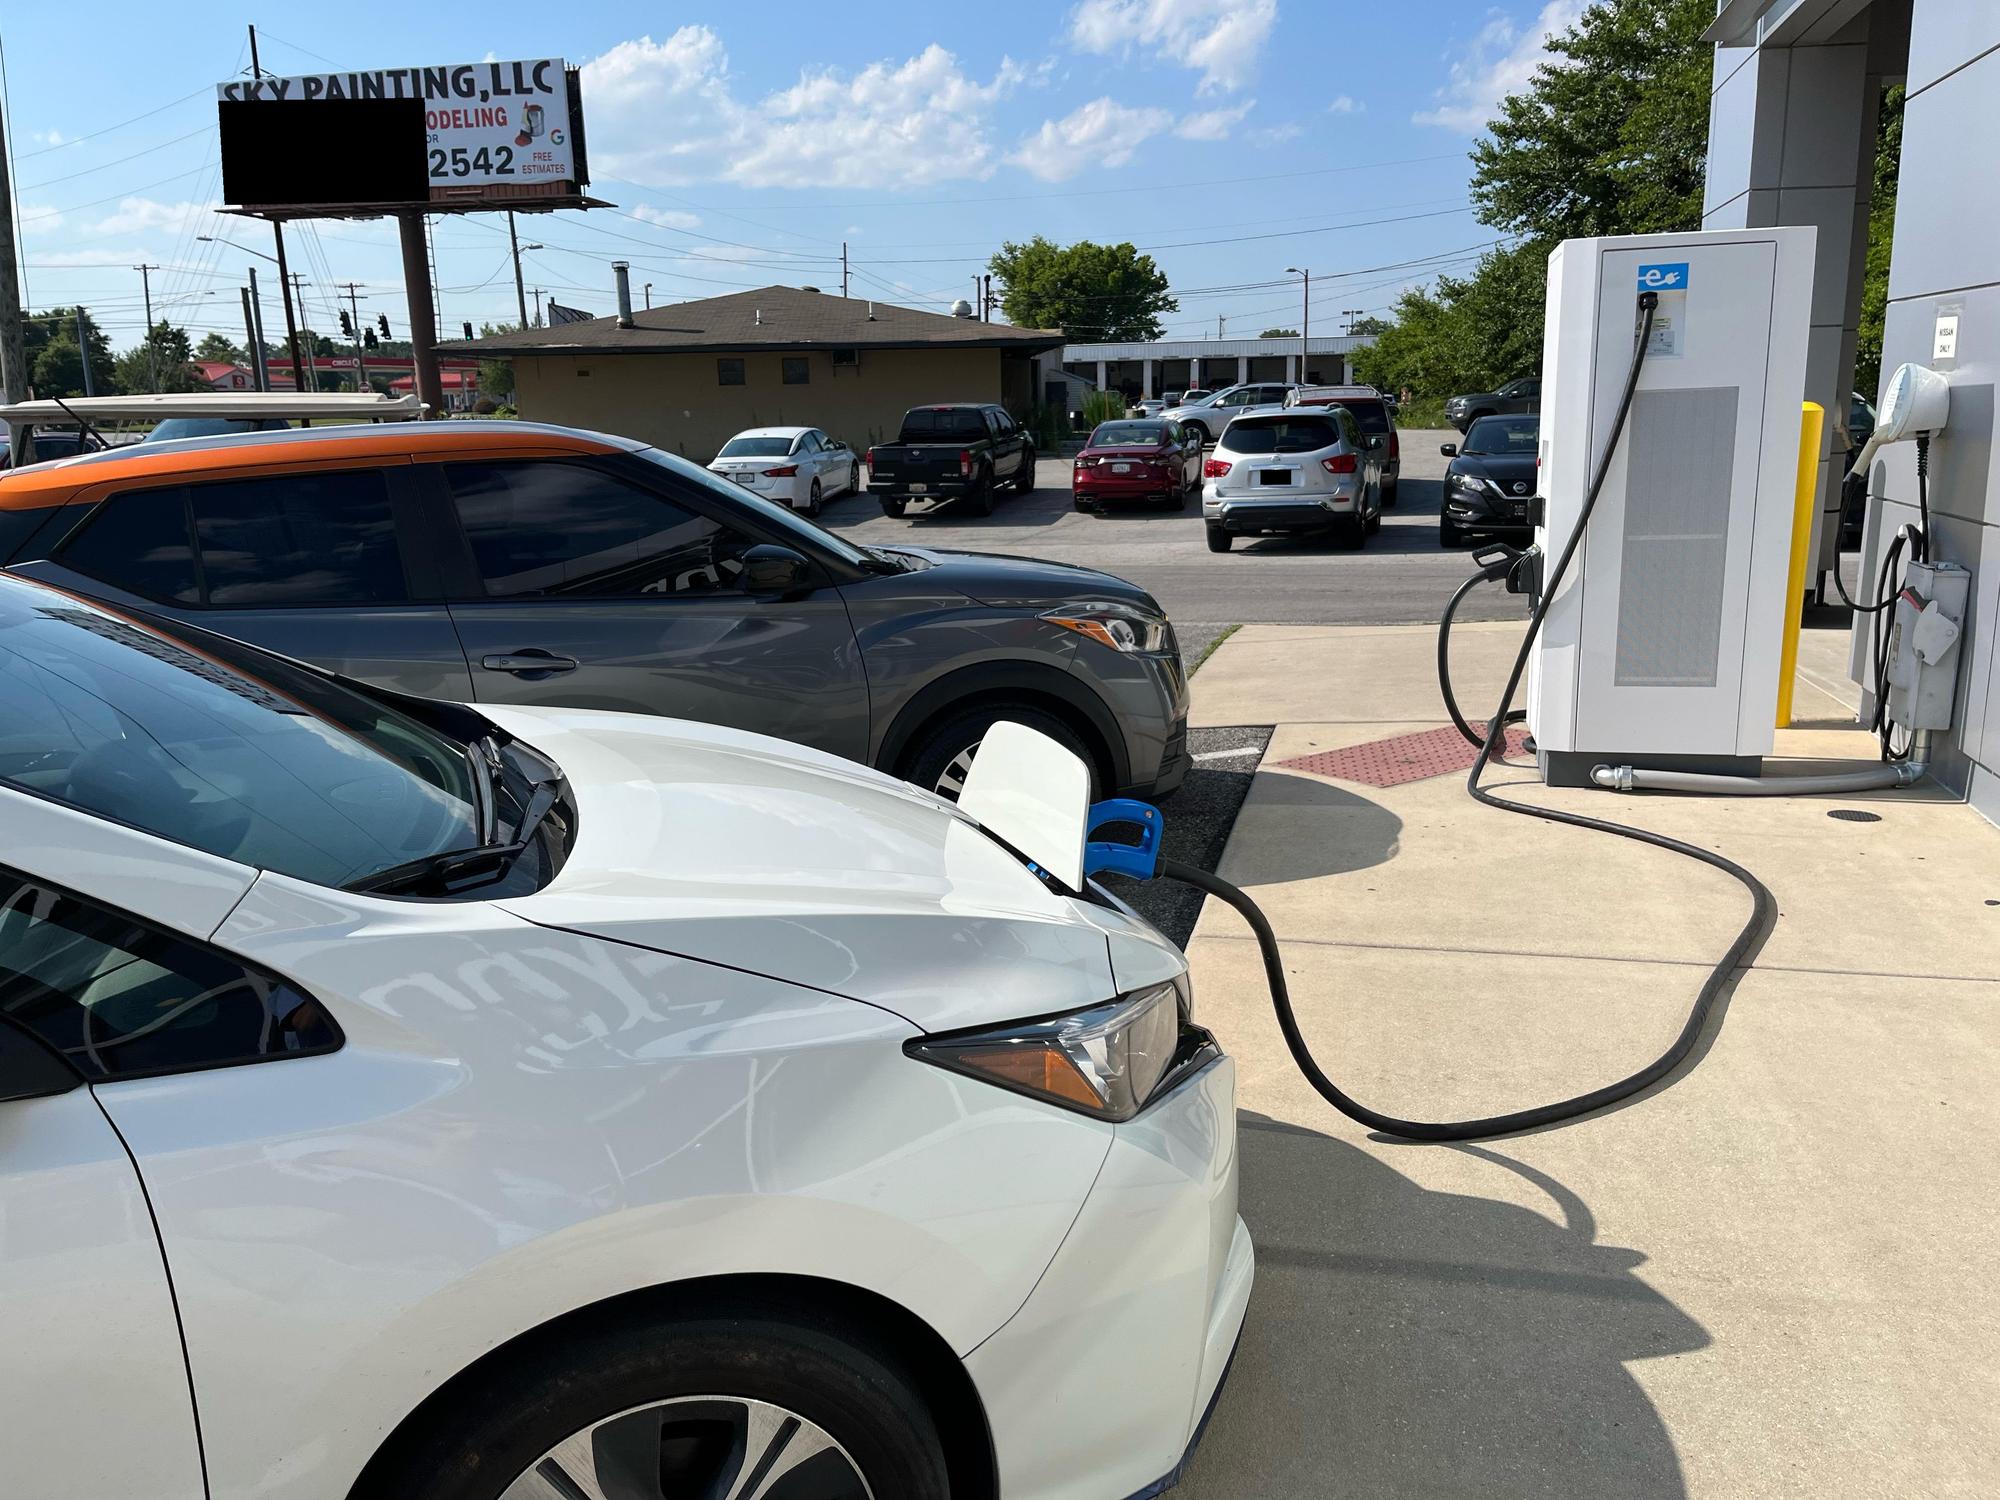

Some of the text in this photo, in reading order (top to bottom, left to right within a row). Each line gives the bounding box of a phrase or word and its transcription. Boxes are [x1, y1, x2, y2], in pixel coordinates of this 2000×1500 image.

[224, 80, 290, 101] SKY
[426, 107, 507, 130] ODELING
[429, 146, 515, 178] 2542
[533, 152, 553, 162] FREE
[522, 164, 566, 174] ESTIMATES
[1939, 344, 1951, 353] ONLY
